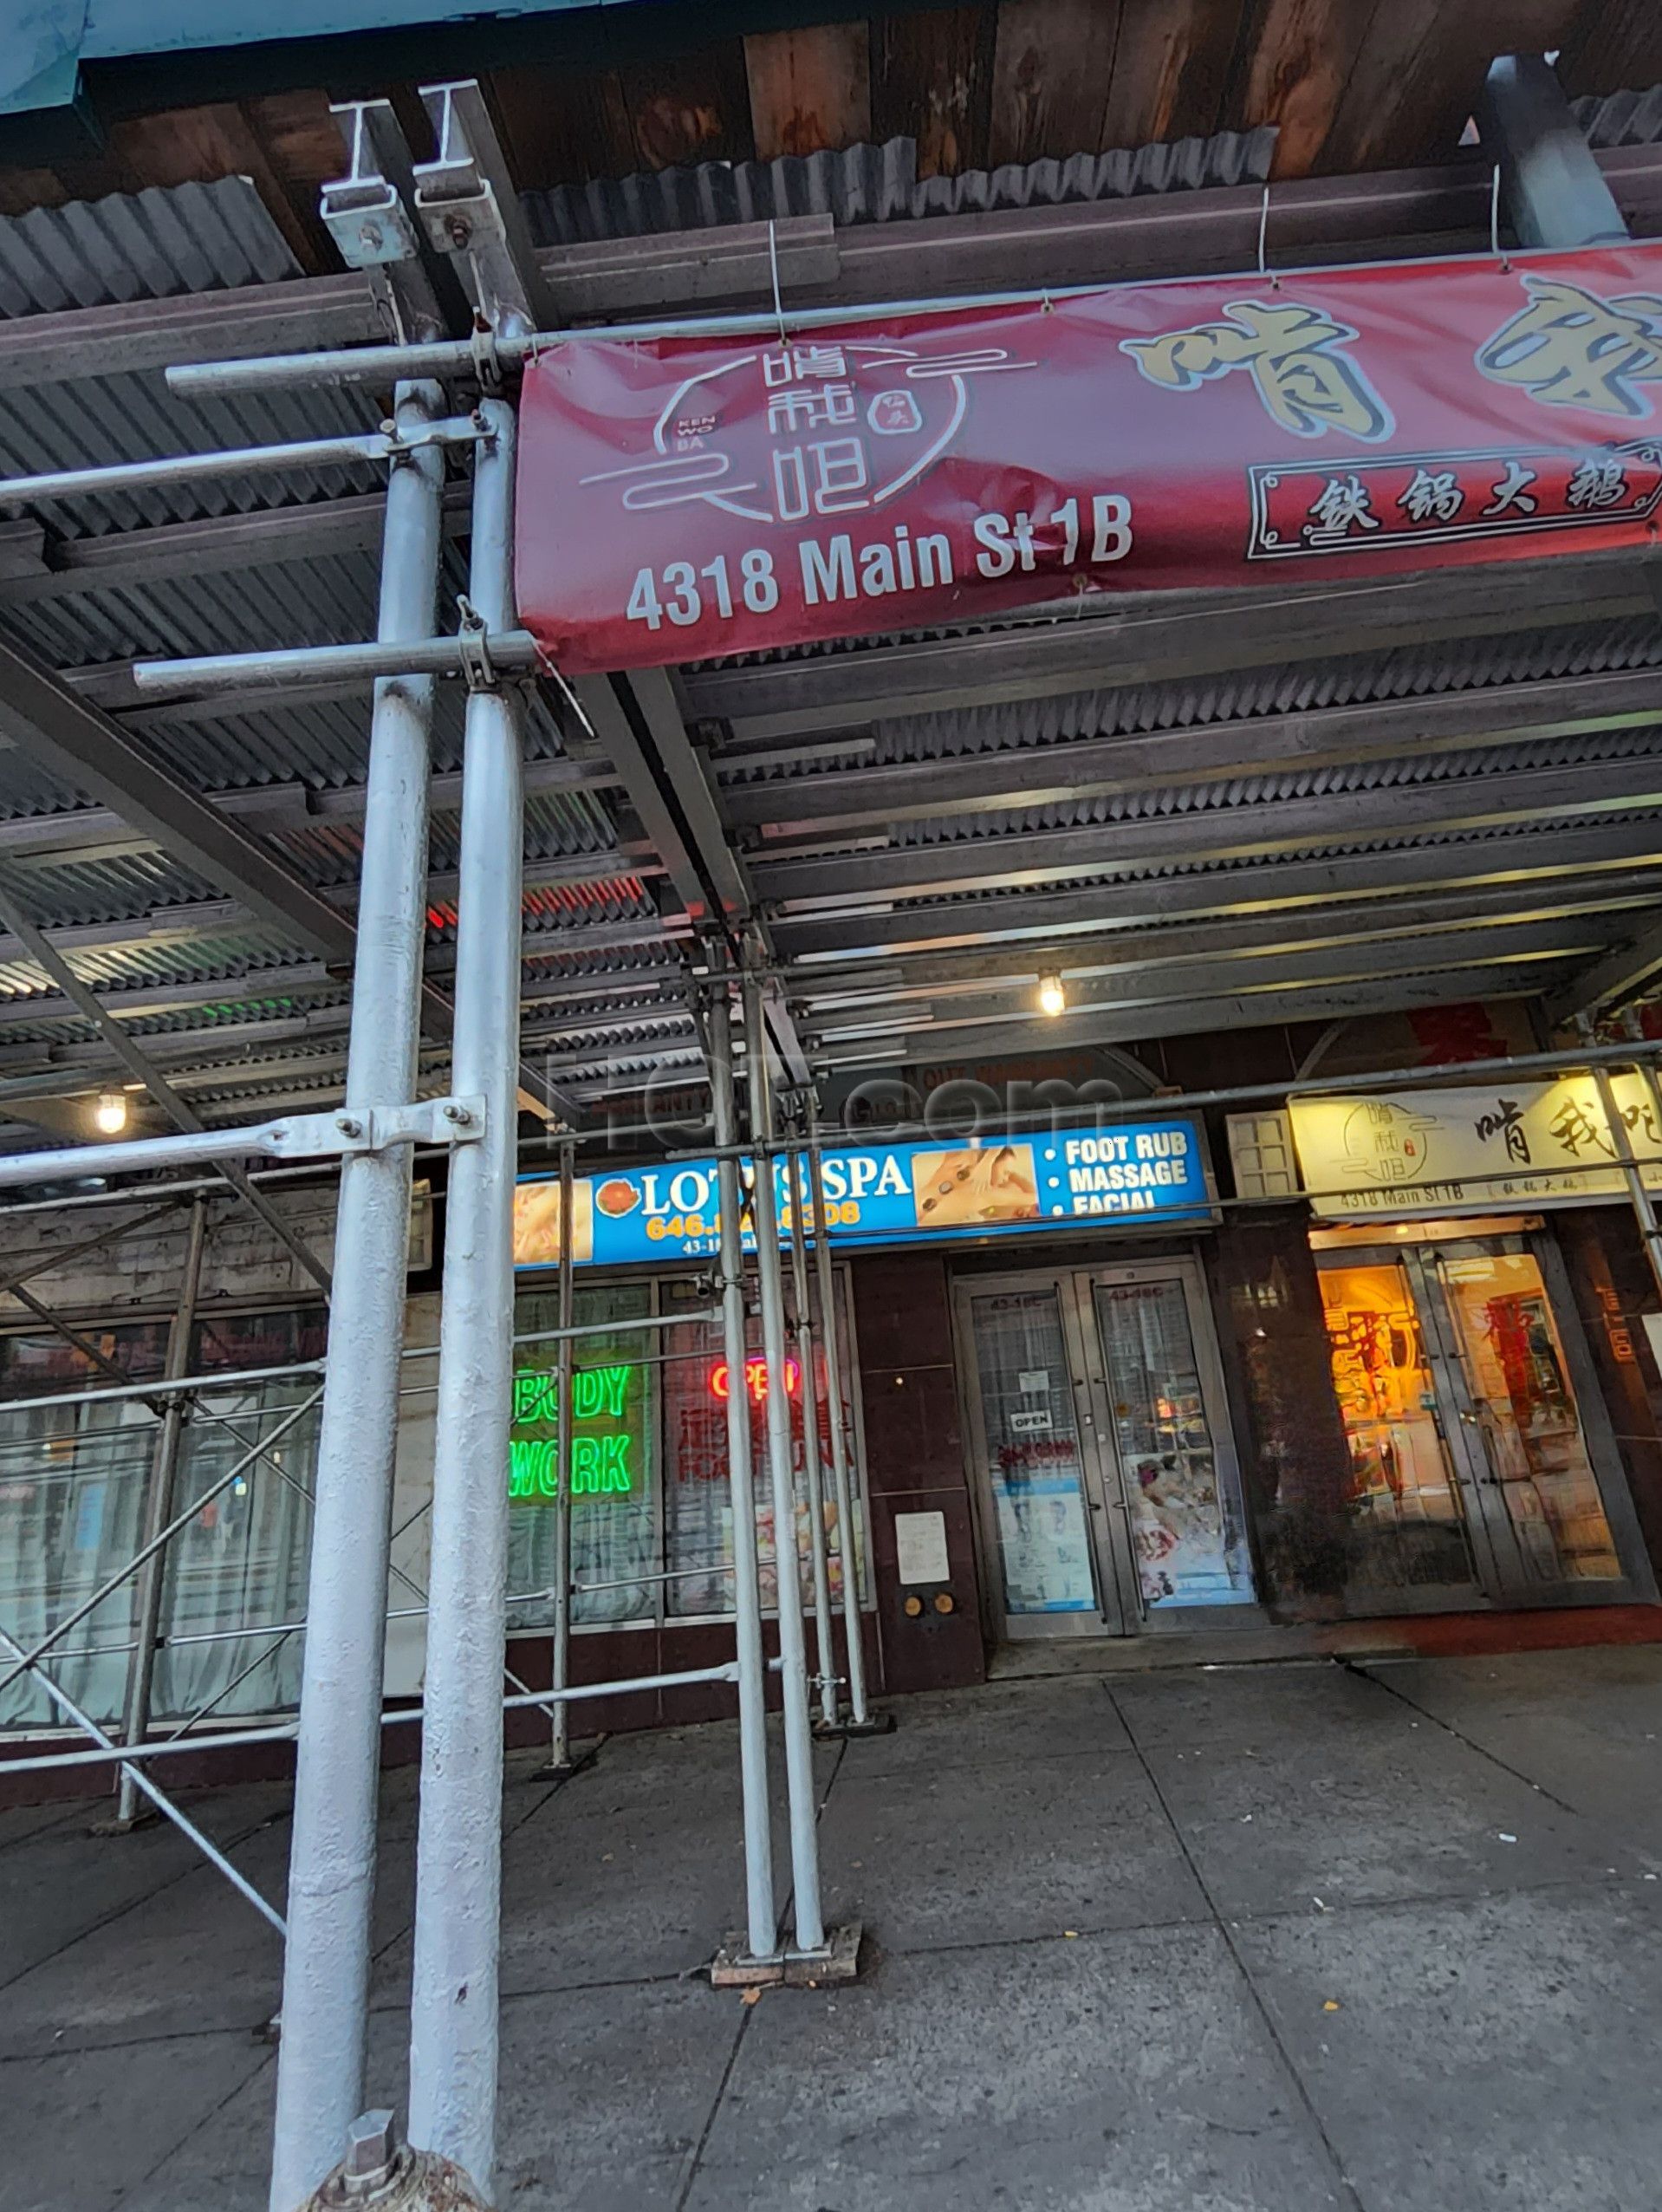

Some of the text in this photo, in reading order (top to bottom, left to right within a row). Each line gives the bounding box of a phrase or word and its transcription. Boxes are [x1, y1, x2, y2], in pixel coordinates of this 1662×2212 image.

[678, 416, 716, 428] KEN
[678, 425, 713, 436] WO
[678, 436, 704, 452] BA
[626, 494, 1133, 630] 4318 Main St 1B
[1065, 1132, 1188, 1165] FOOT RUB
[641, 1155, 913, 1215] LOS SPA
[1068, 1159, 1188, 1193] MASSAGE
[1381, 1187, 1420, 1206] Main
[515, 1364, 631, 1423] BODY
[1016, 1415, 1049, 1428] OPEN
[509, 1435, 632, 1497] WORK
